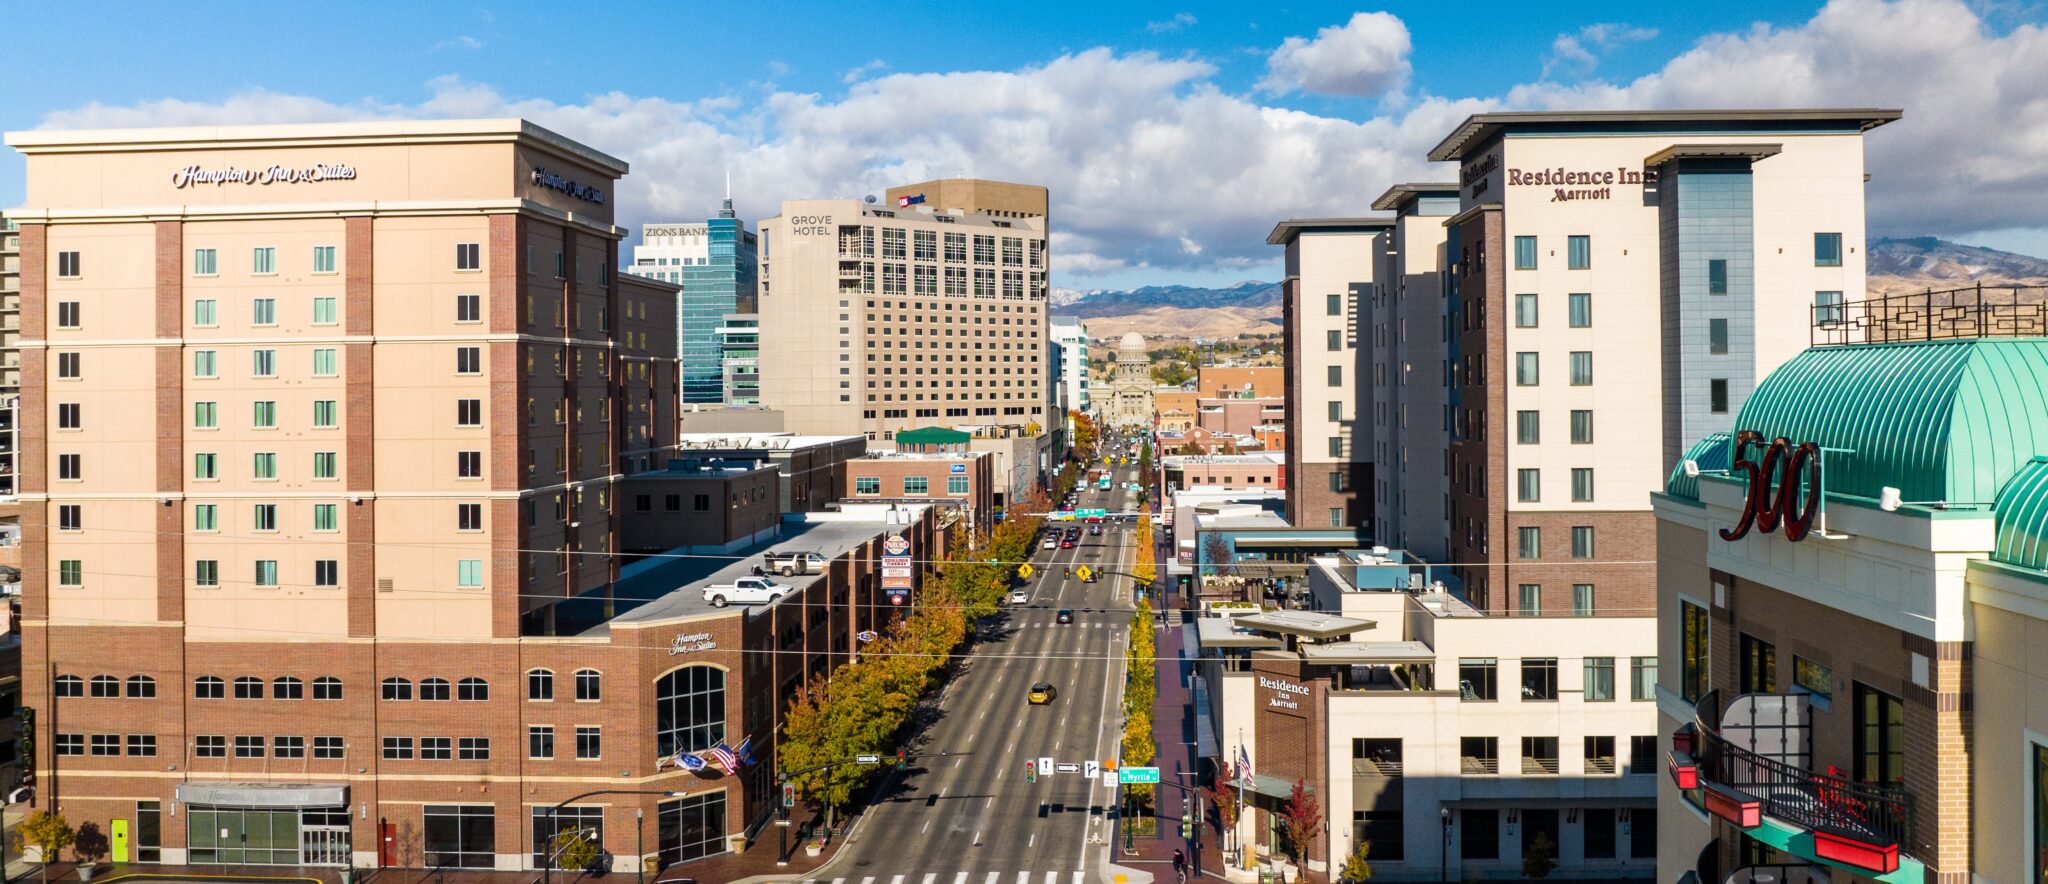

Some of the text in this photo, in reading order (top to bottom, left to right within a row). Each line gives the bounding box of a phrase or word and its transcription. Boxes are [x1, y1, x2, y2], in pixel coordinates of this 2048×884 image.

[173, 165, 256, 189] Hampton
[259, 165, 301, 185] Inn
[311, 163, 357, 182] Suites
[1508, 167, 1657, 186] Residence Inn
[1550, 187, 1611, 202] Marriott
[791, 215, 832, 225] GROVE
[645, 228, 708, 237] ZIONS BANK
[793, 226, 831, 236] HOTEL
[1719, 430, 1821, 542] 500
[672, 632, 713, 645] Hampton
[669, 645, 689, 656] Inn
[696, 641, 717, 651] Suites
[1260, 676, 1310, 695] Residence
[1278, 691, 1290, 700] Inn
[1269, 698, 1298, 710] Marriott
[1127, 772, 1151, 784] Myrtle
